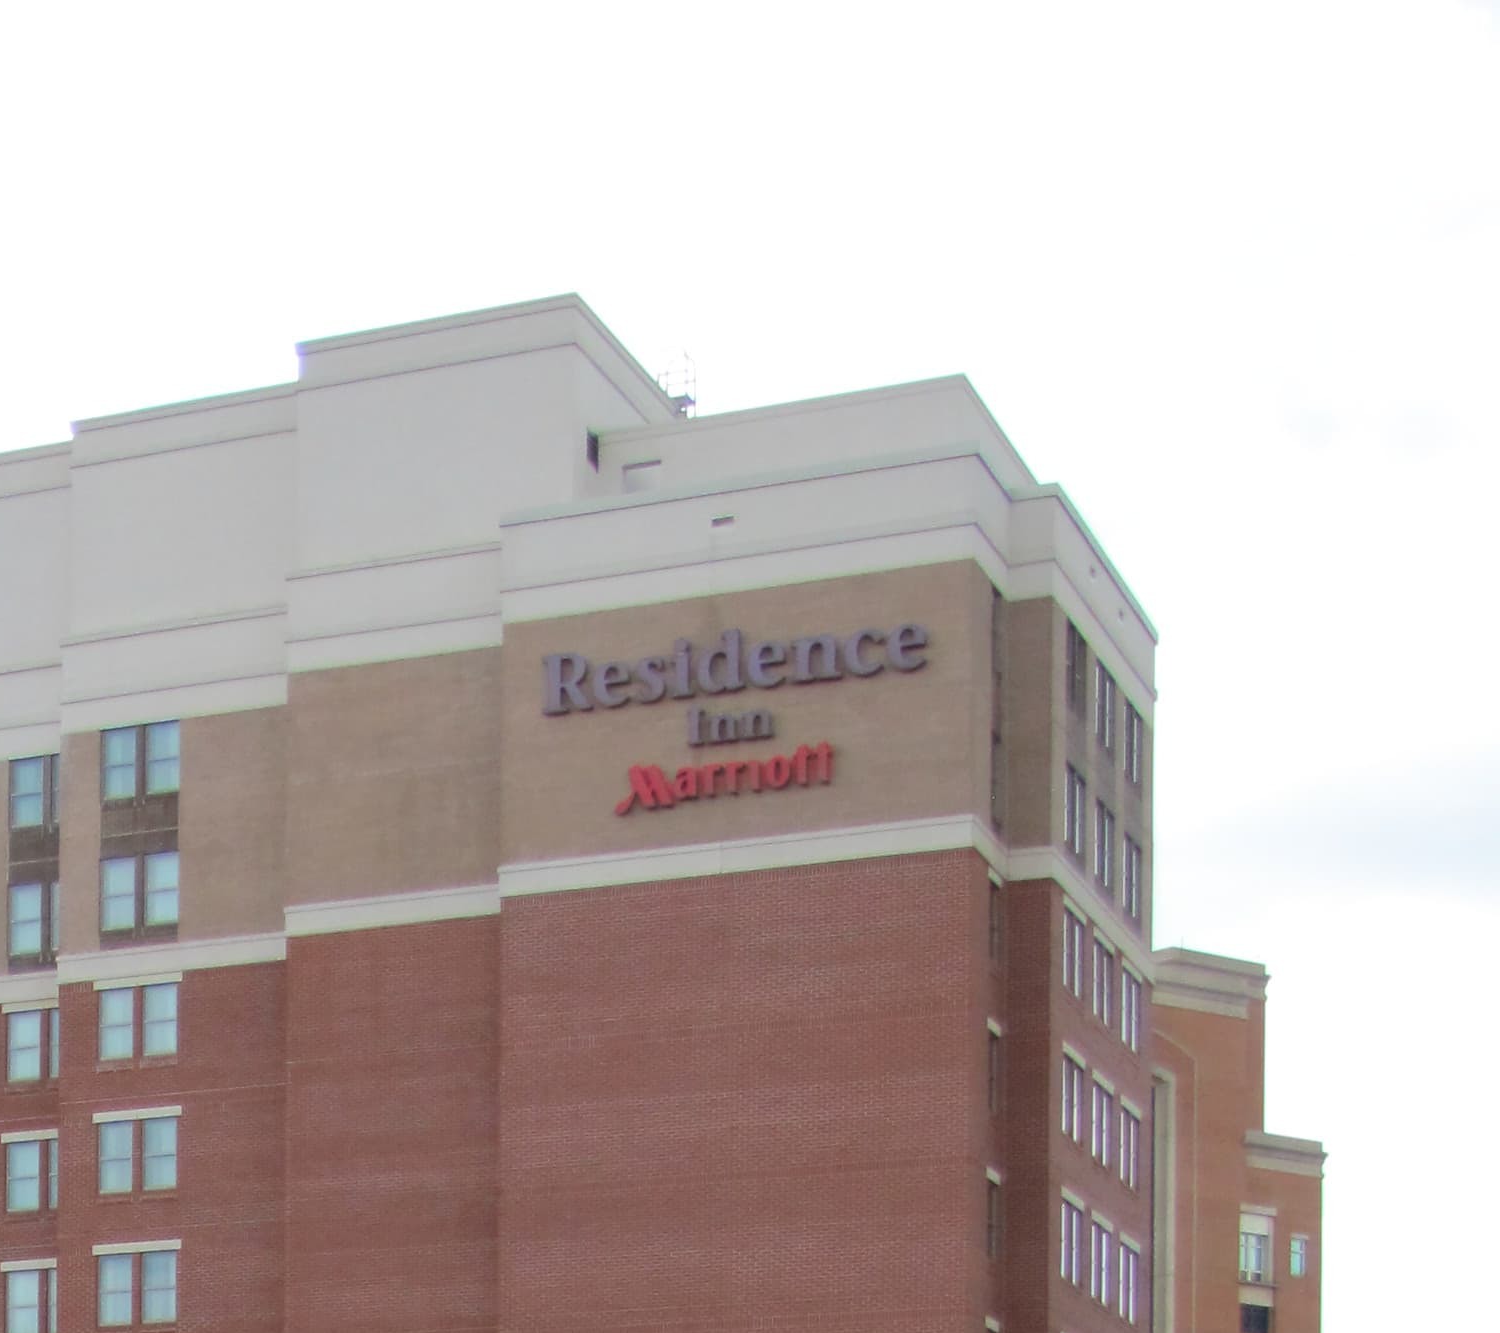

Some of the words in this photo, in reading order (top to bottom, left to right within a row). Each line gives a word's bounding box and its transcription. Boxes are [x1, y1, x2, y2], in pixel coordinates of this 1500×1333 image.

[543, 622, 929, 716] Residence
[688, 705, 775, 746] Inn
[614, 741, 834, 816] Marriott
